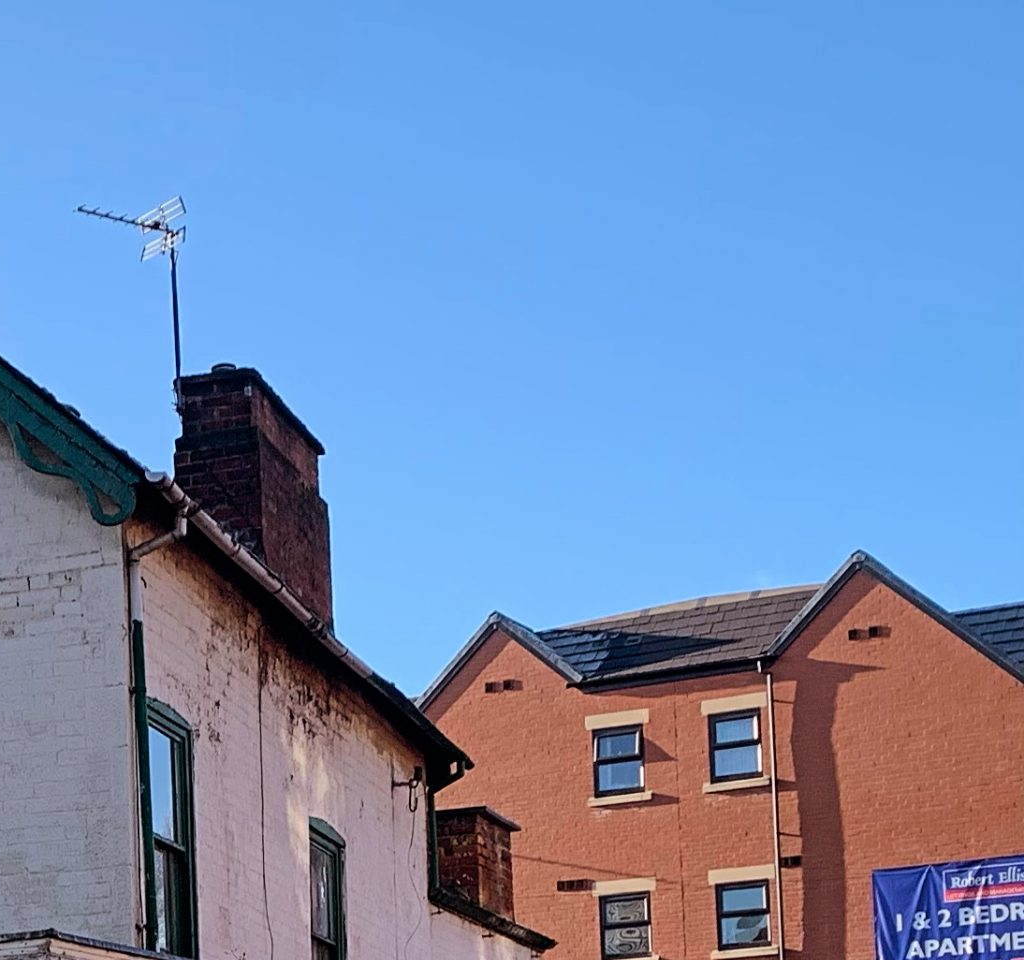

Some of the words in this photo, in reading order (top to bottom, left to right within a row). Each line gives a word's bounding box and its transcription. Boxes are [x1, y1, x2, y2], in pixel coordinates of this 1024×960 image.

[950, 870, 994, 889] Robert
[912, 911, 931, 931] &
[937, 908, 952, 928] 2
[958, 902, 1024, 926] BEDR
[906, 931, 1024, 960] APARTME
